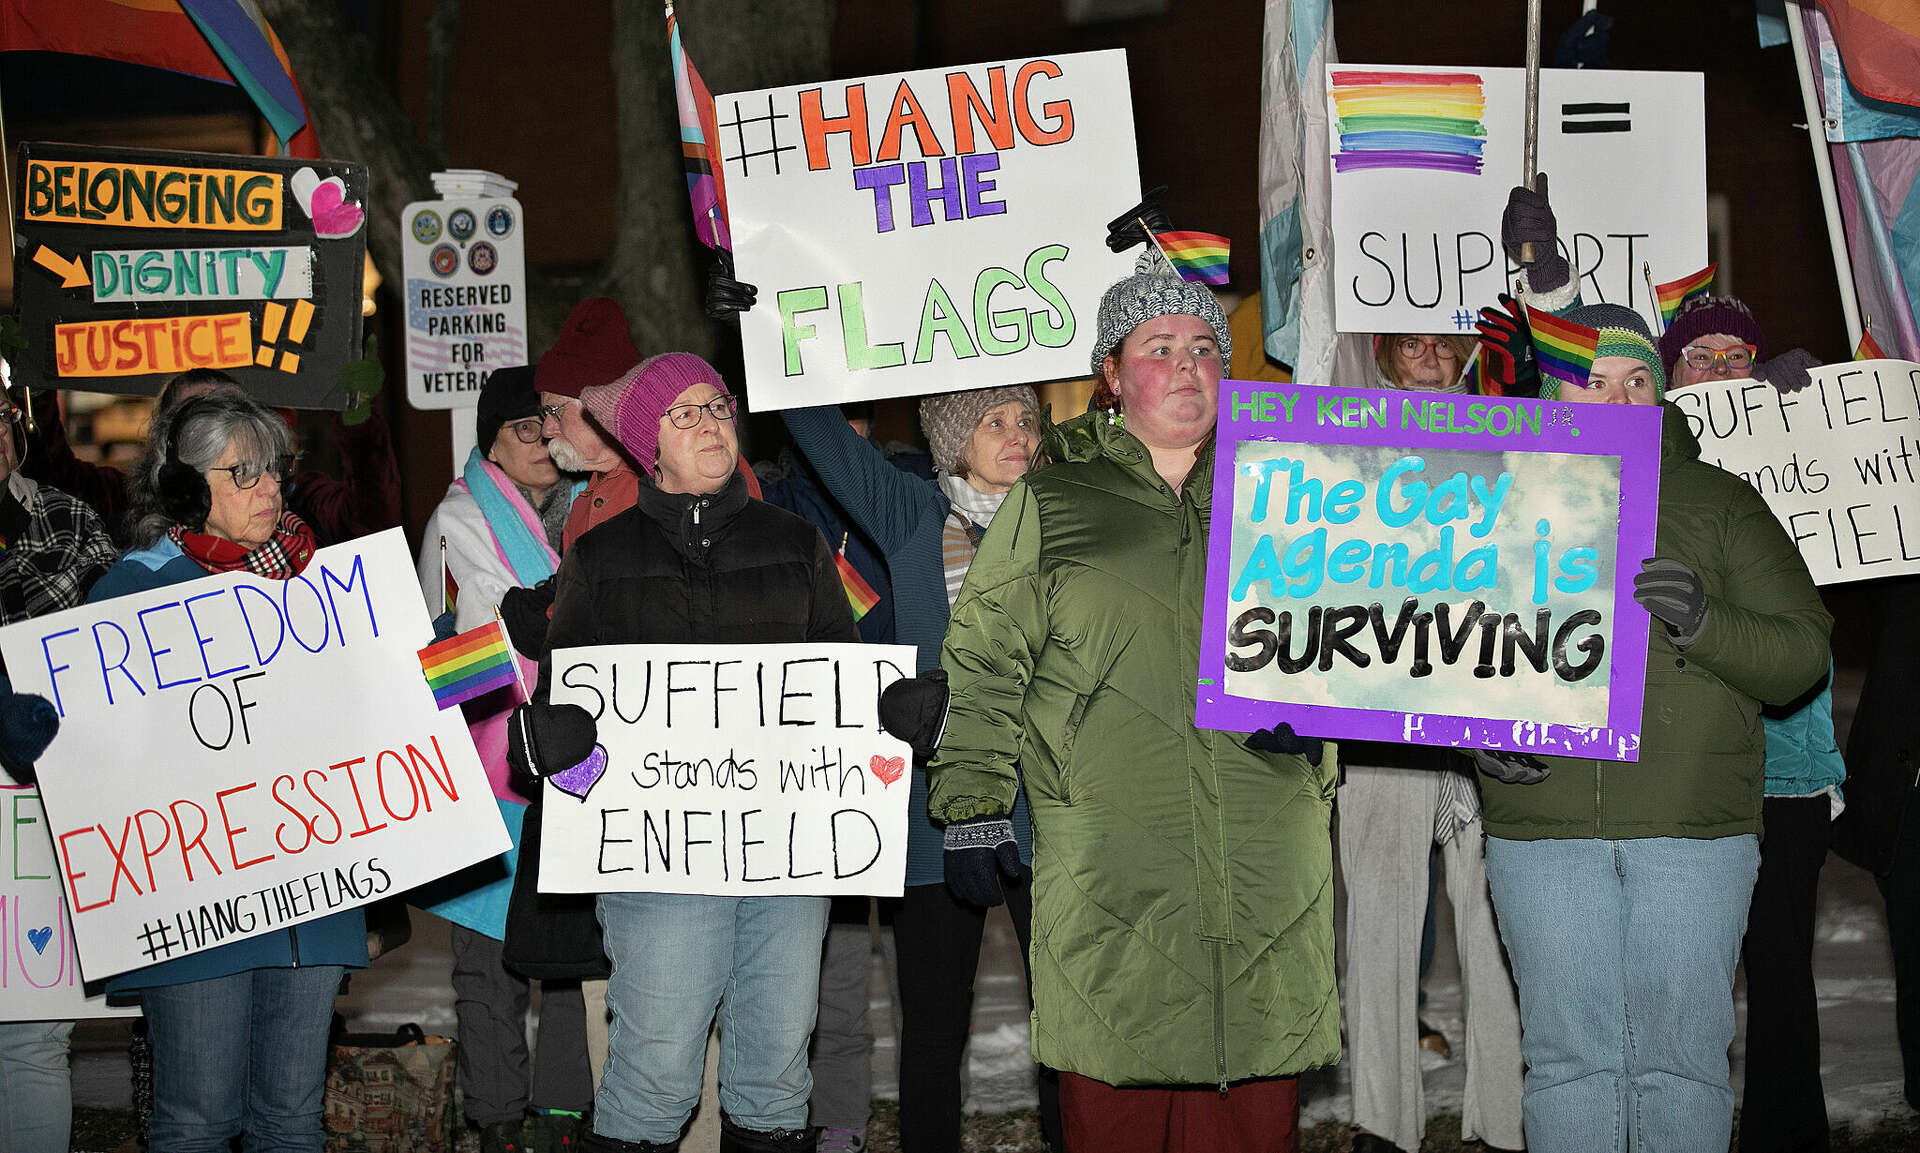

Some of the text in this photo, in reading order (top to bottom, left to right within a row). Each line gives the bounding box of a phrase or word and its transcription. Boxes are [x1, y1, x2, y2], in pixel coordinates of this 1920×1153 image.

[718, 60, 1076, 178] #HANG
[853, 153, 1007, 234] THE
[421, 284, 512, 308] RESERVED
[1352, 231, 1649, 308] SUPRT
[428, 313, 506, 336] PARKING
[776, 244, 1077, 377] FLAGS
[423, 371, 489, 393] VETERA
[451, 343, 485, 363] FOR
[1231, 391, 1300, 423] HEY
[1317, 396, 1388, 429] KEN
[1401, 399, 1543, 436] NELSON
[1240, 456, 1513, 538] The Gay
[1854, 435, 1920, 485] wit
[1230, 518, 1600, 605] Agenda is
[1789, 504, 1920, 569] FIEL
[40, 554, 380, 718] FREEDOM
[1224, 596, 1606, 682] SURVIVING
[189, 671, 267, 751] OF
[632, 746, 866, 798] stands with
[58, 735, 460, 914] EXPRESSION
[597, 808, 882, 883] ENFIELD
[137, 857, 393, 961] #HANGTHEFLAGS
